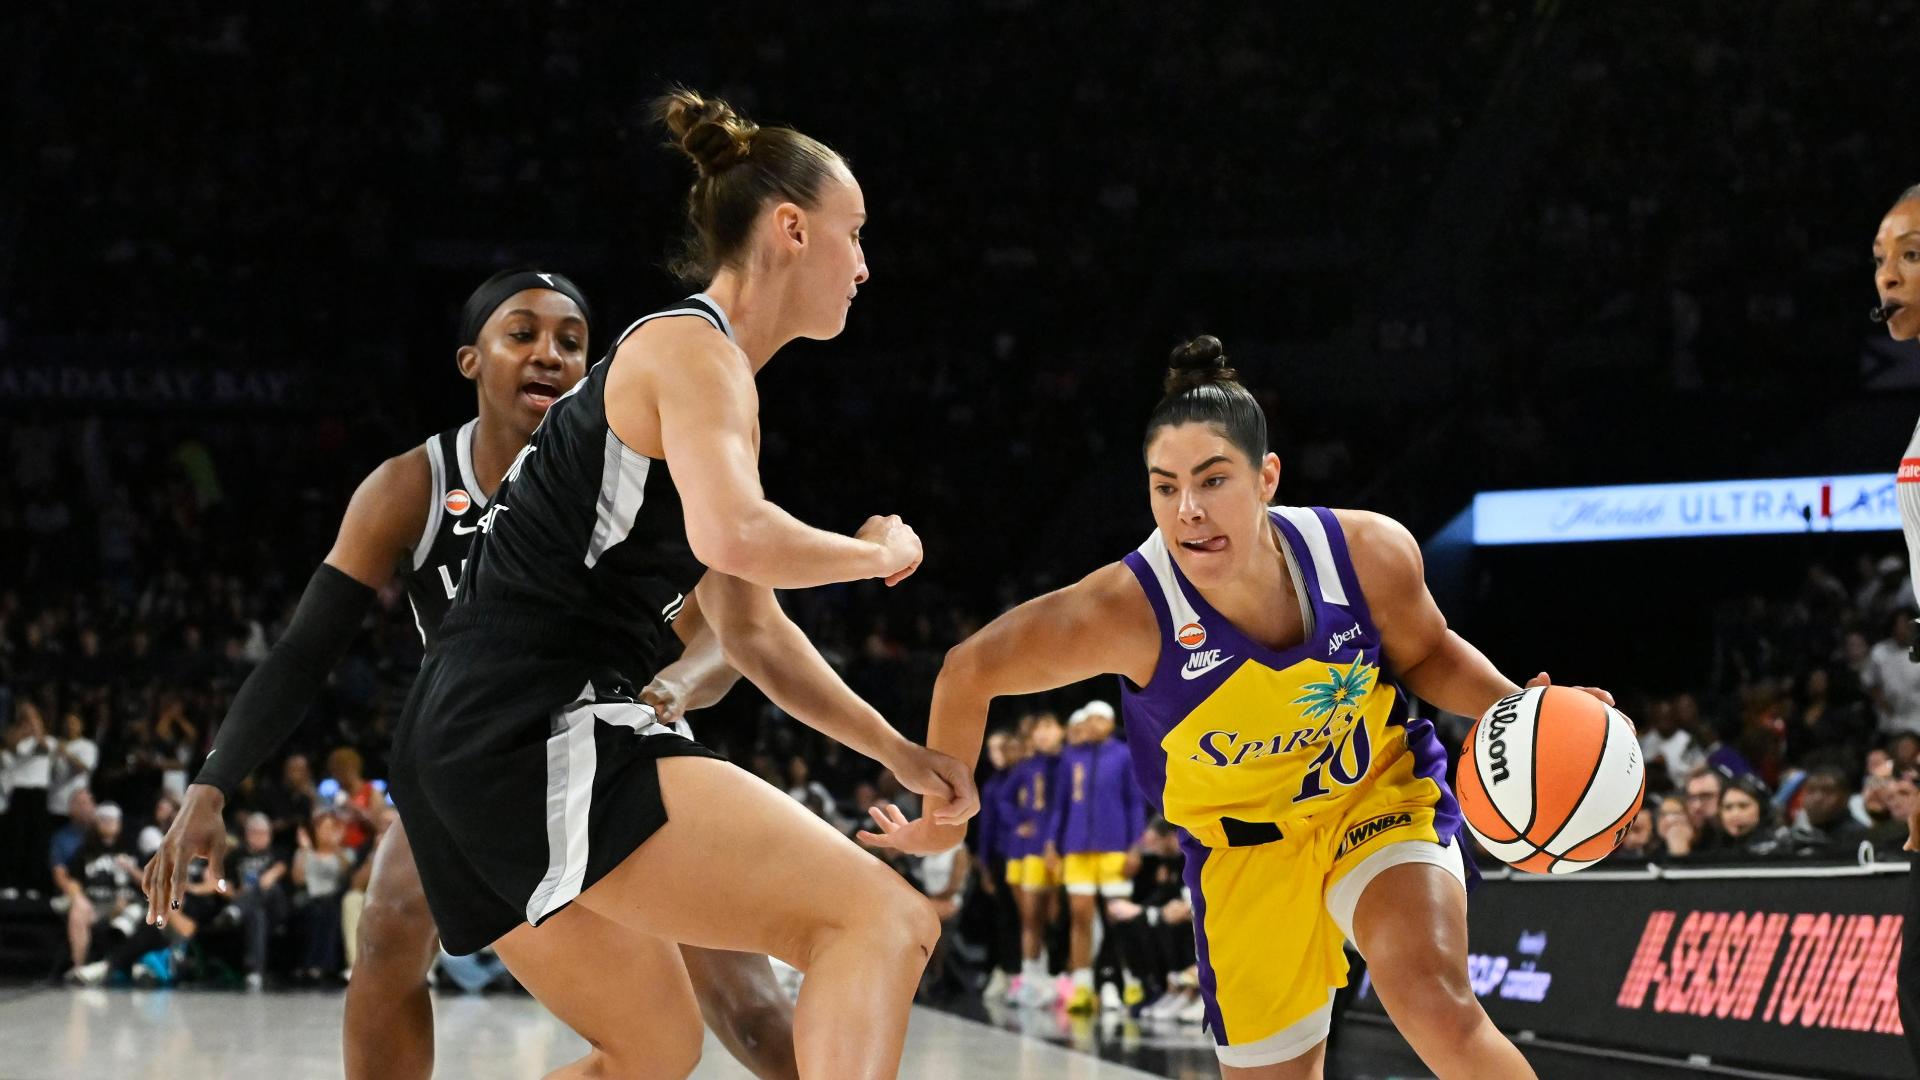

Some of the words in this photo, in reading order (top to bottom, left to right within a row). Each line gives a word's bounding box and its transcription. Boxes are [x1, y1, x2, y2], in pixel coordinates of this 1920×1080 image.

[1680, 491, 1798, 523] ULTRA
[1188, 649, 1221, 669] NIKE
[1292, 714, 1372, 803] 10
[1349, 814, 1412, 846] WNBA
